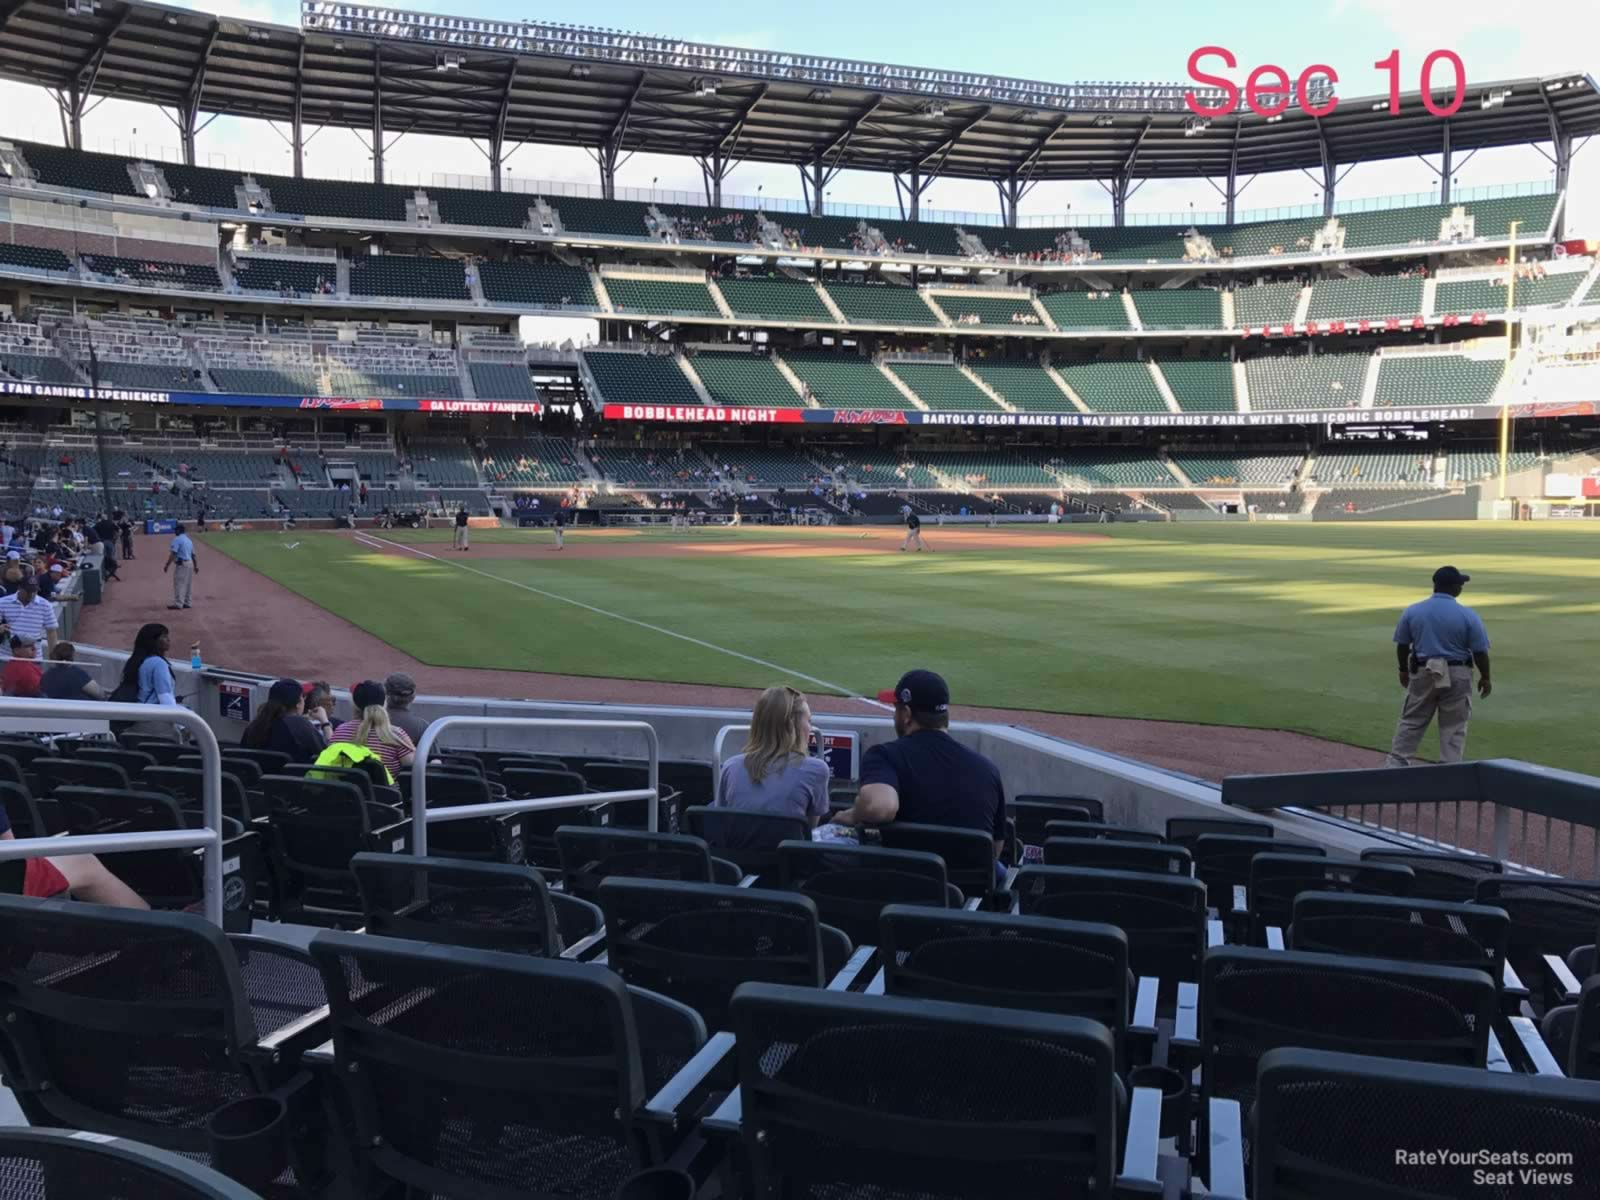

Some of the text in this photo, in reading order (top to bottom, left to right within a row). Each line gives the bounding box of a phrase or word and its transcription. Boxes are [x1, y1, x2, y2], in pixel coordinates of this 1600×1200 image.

[8, 383, 32, 394] FAN
[35, 385, 86, 398] GAMING
[430, 401, 535, 413] GA LOTTERY FANBEAT
[623, 406, 777, 421] BOBBLEHEAD NIGHT
[922, 408, 1474, 426] BARTOLO COLON MAKES HIS WAY INTO SUNTRUST PARK WITH THIS ICONIC BOBBLEHEAD!
